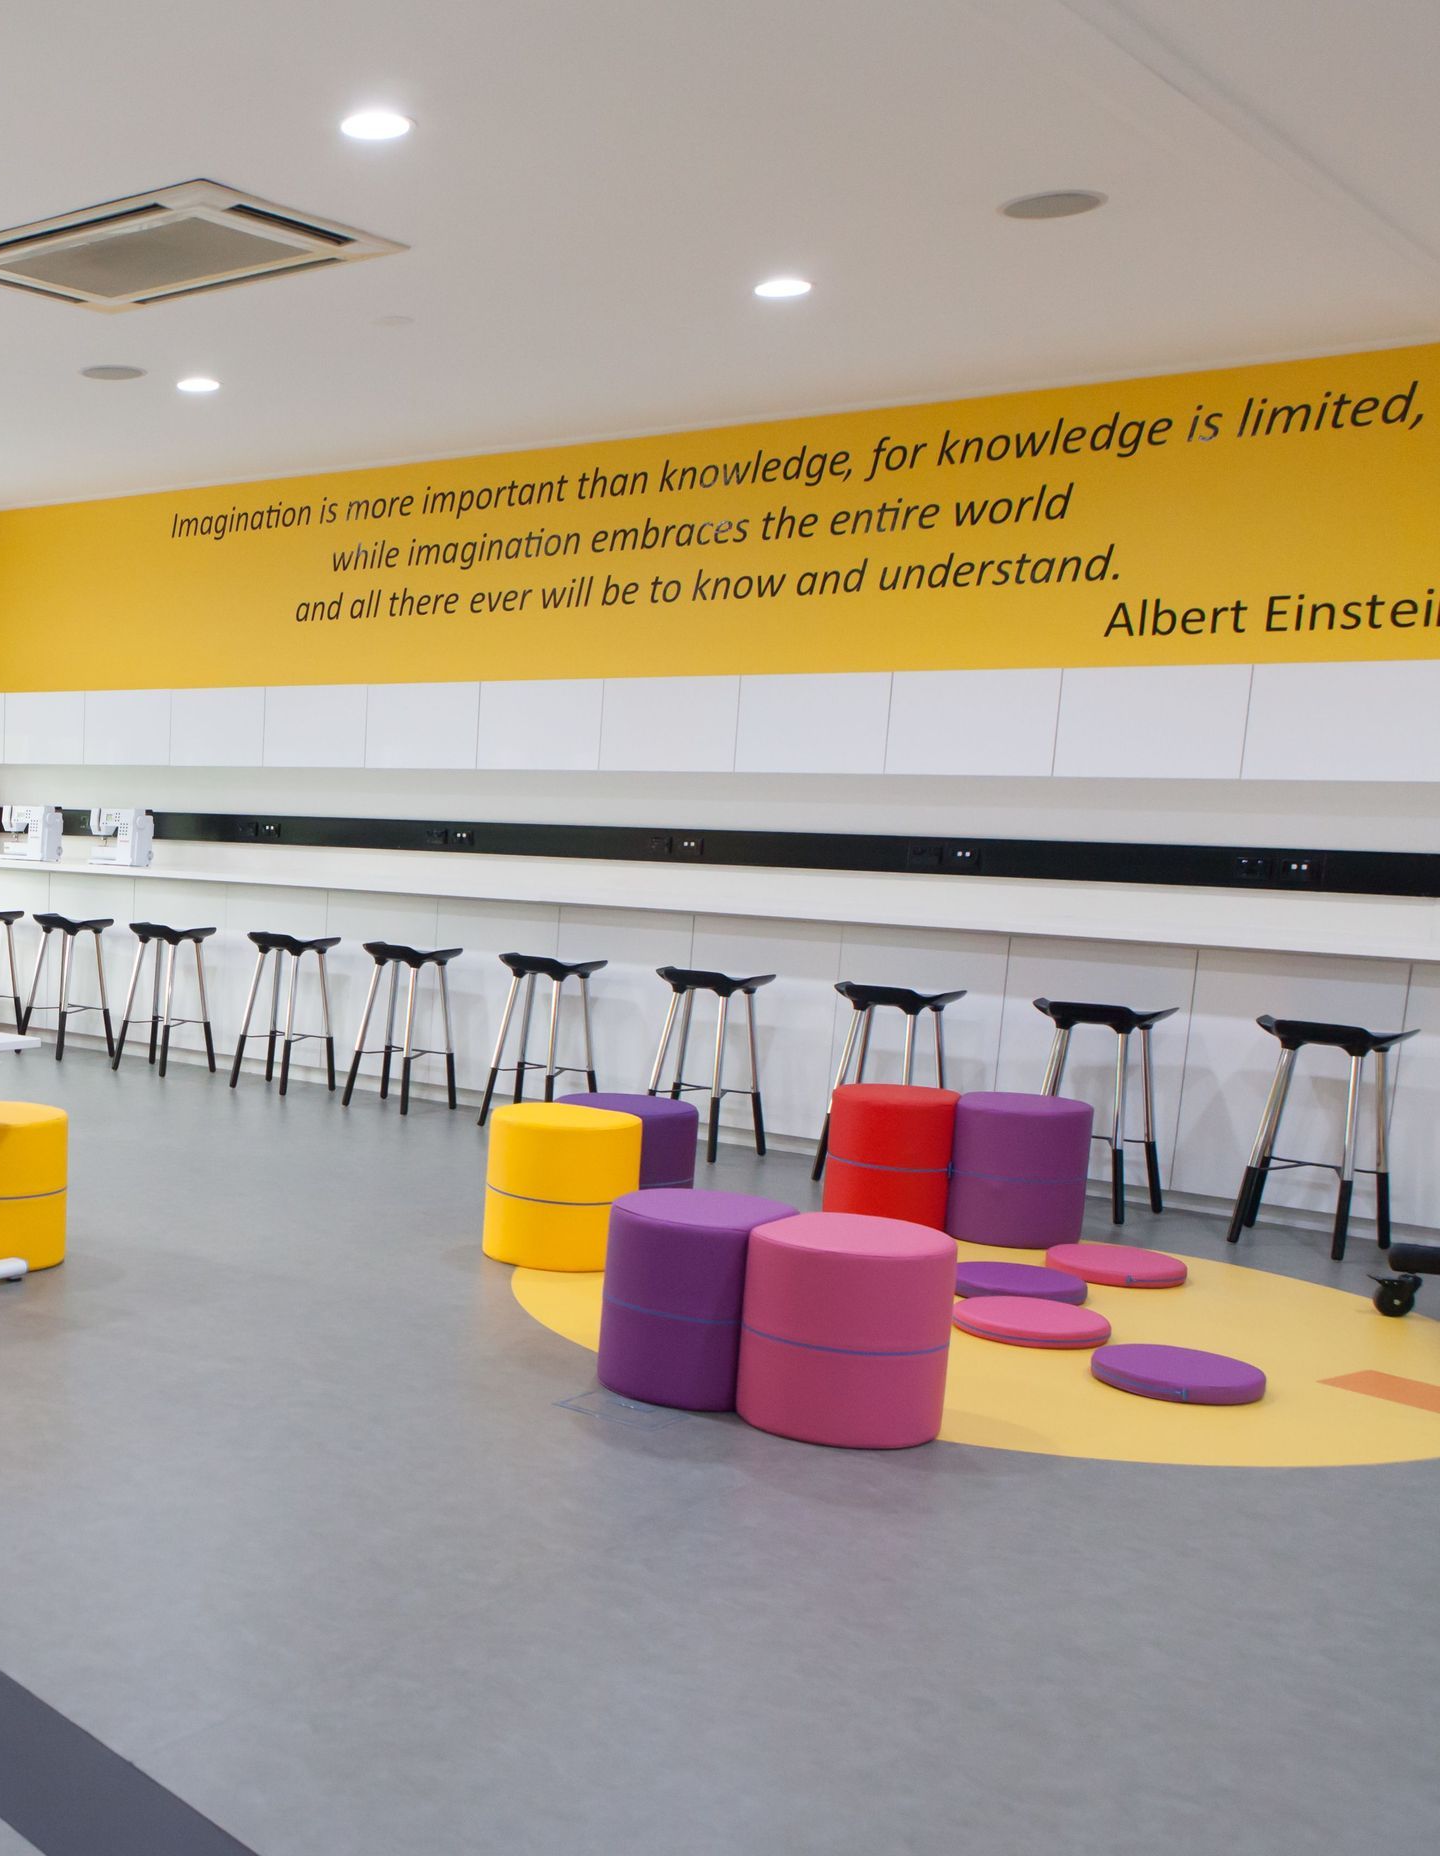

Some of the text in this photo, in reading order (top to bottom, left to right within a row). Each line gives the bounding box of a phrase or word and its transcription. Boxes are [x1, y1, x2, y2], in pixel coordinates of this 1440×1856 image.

[171, 379, 1426, 541] Imagination is more important than knowledge, for knowledge is limited,
[332, 481, 1075, 573] while imagination embraces the entire world
[295, 543, 1120, 623] and all there ever will be to know and understand.
[1103, 588, 1440, 638] Albert Einstei
